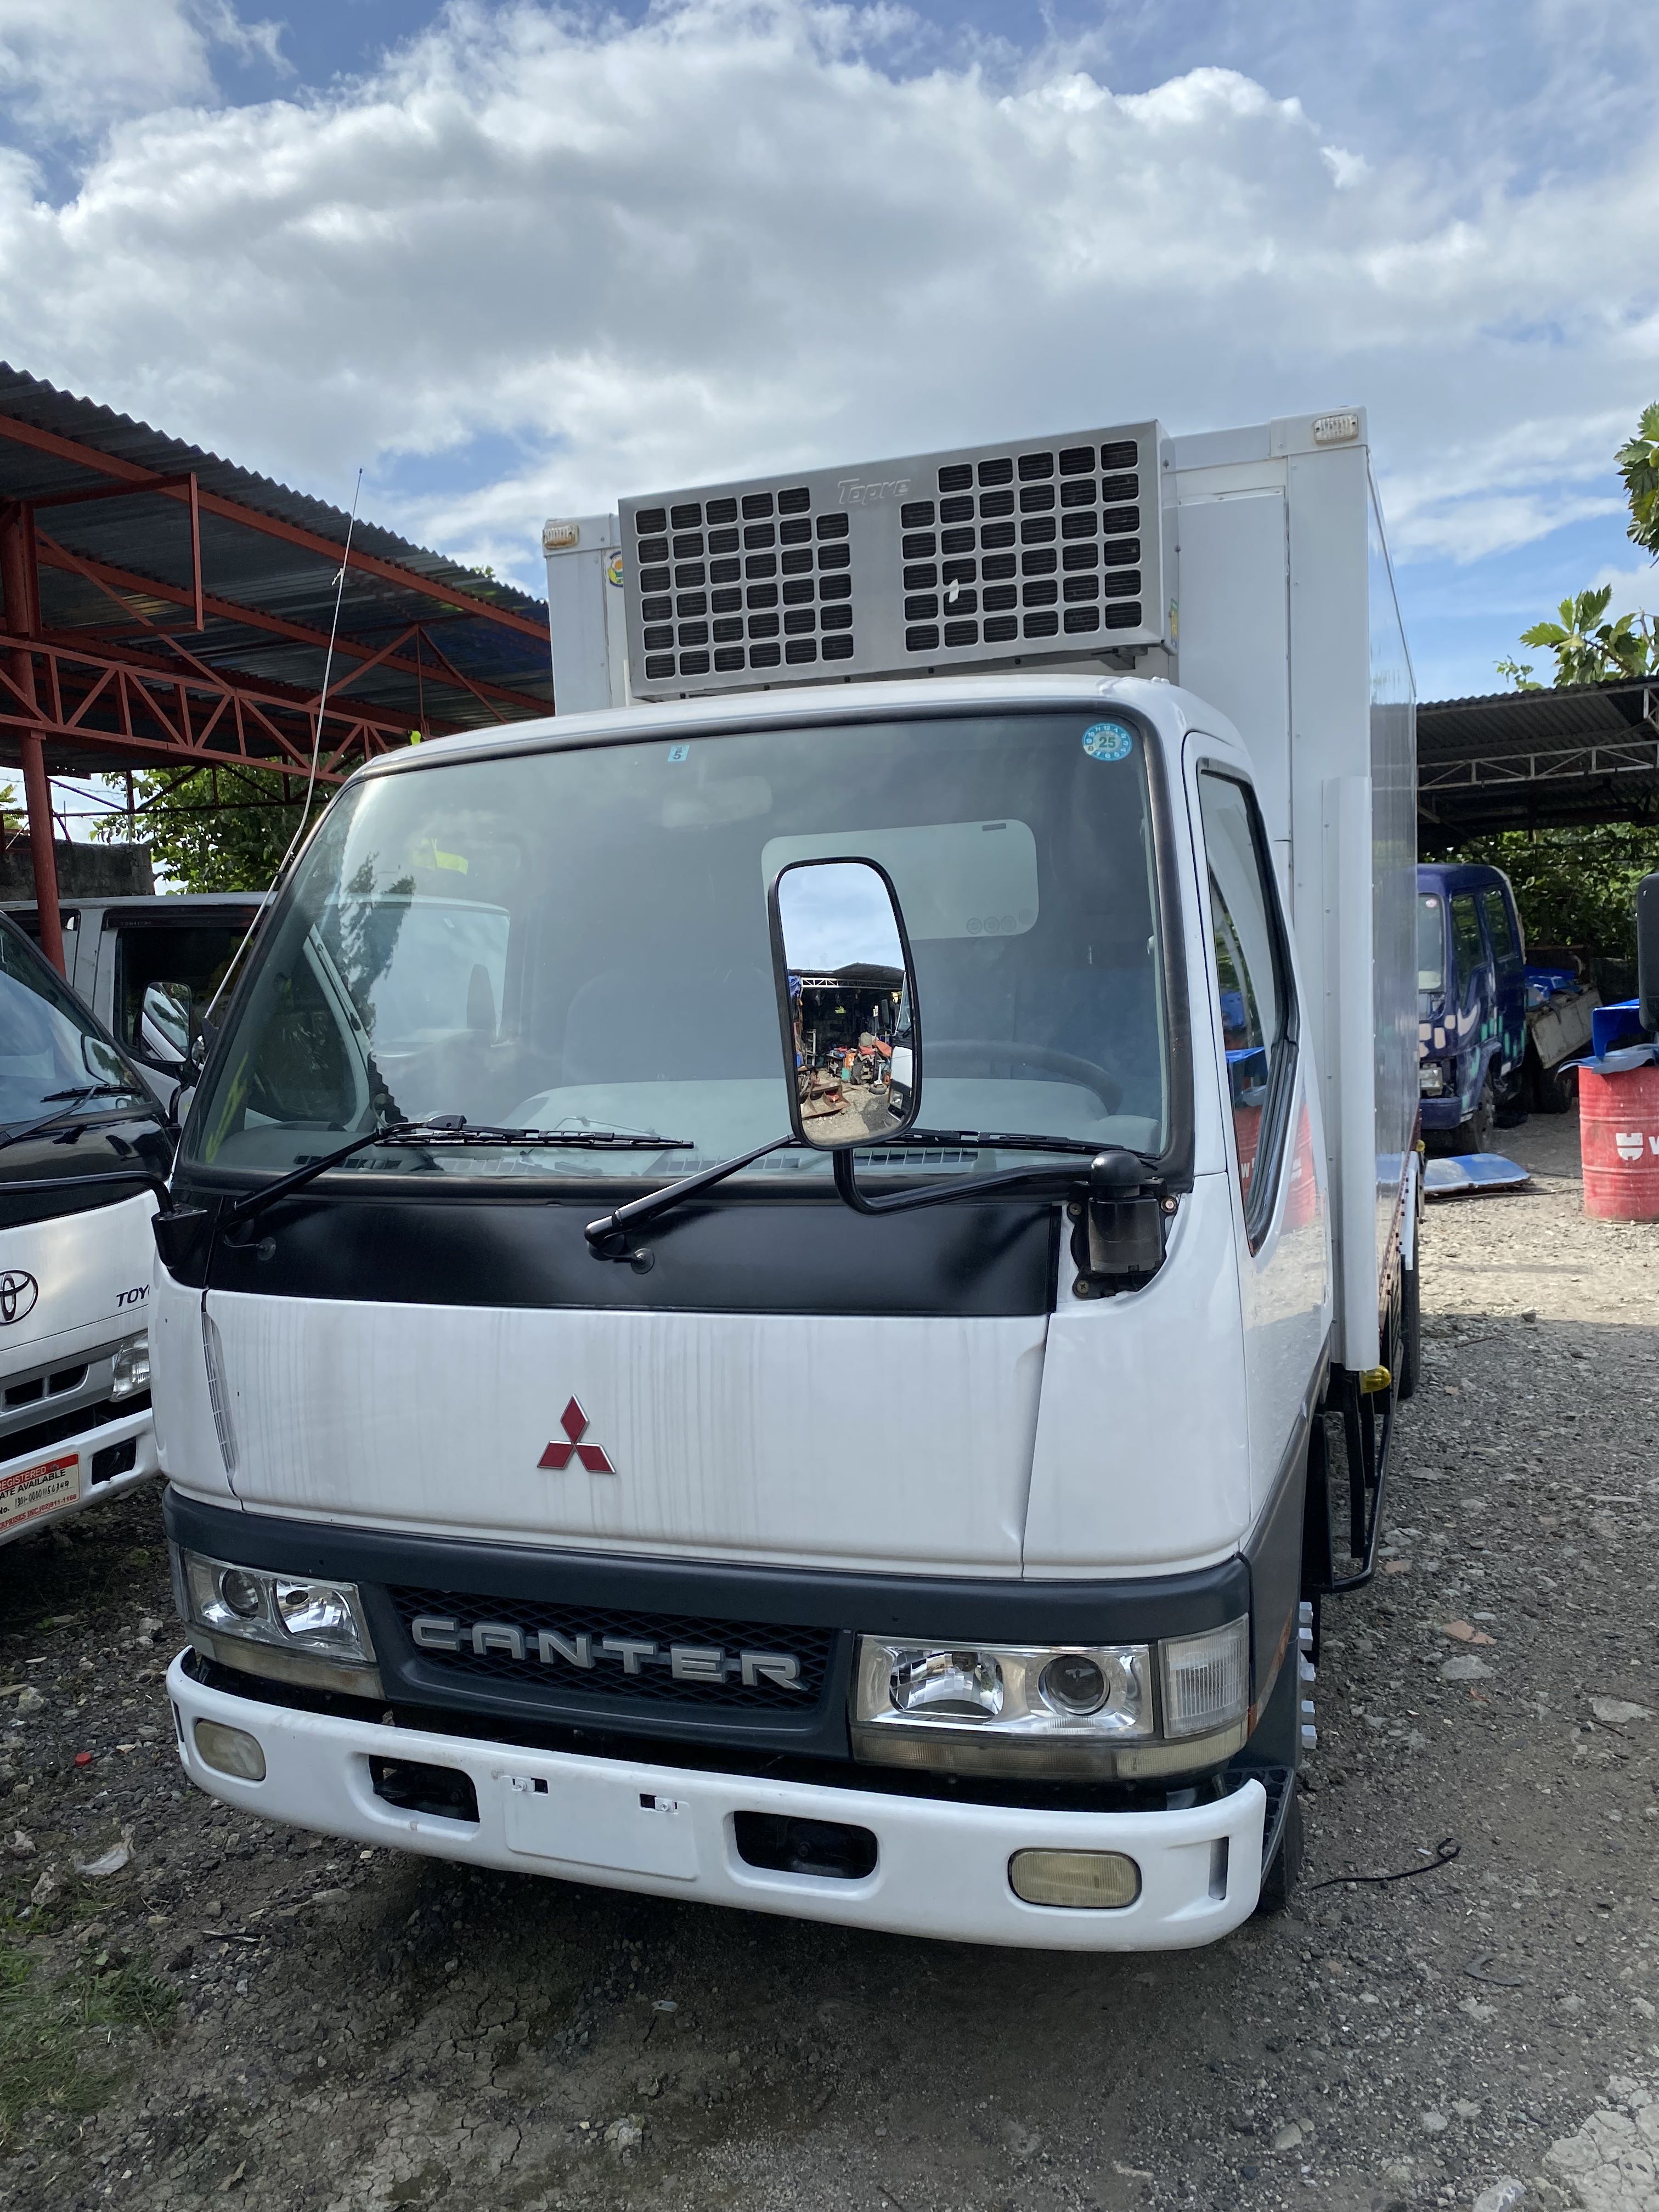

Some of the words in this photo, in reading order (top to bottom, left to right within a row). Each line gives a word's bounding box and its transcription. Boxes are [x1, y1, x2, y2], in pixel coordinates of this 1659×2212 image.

[838, 478, 911, 505] Topre
[1099, 736, 1116, 748] 25
[673, 751, 682, 760] 5
[116, 1284, 150, 1307] TOY
[18, 1469, 66, 1493] AVAILABLE
[412, 1615, 809, 1691] CANTER
